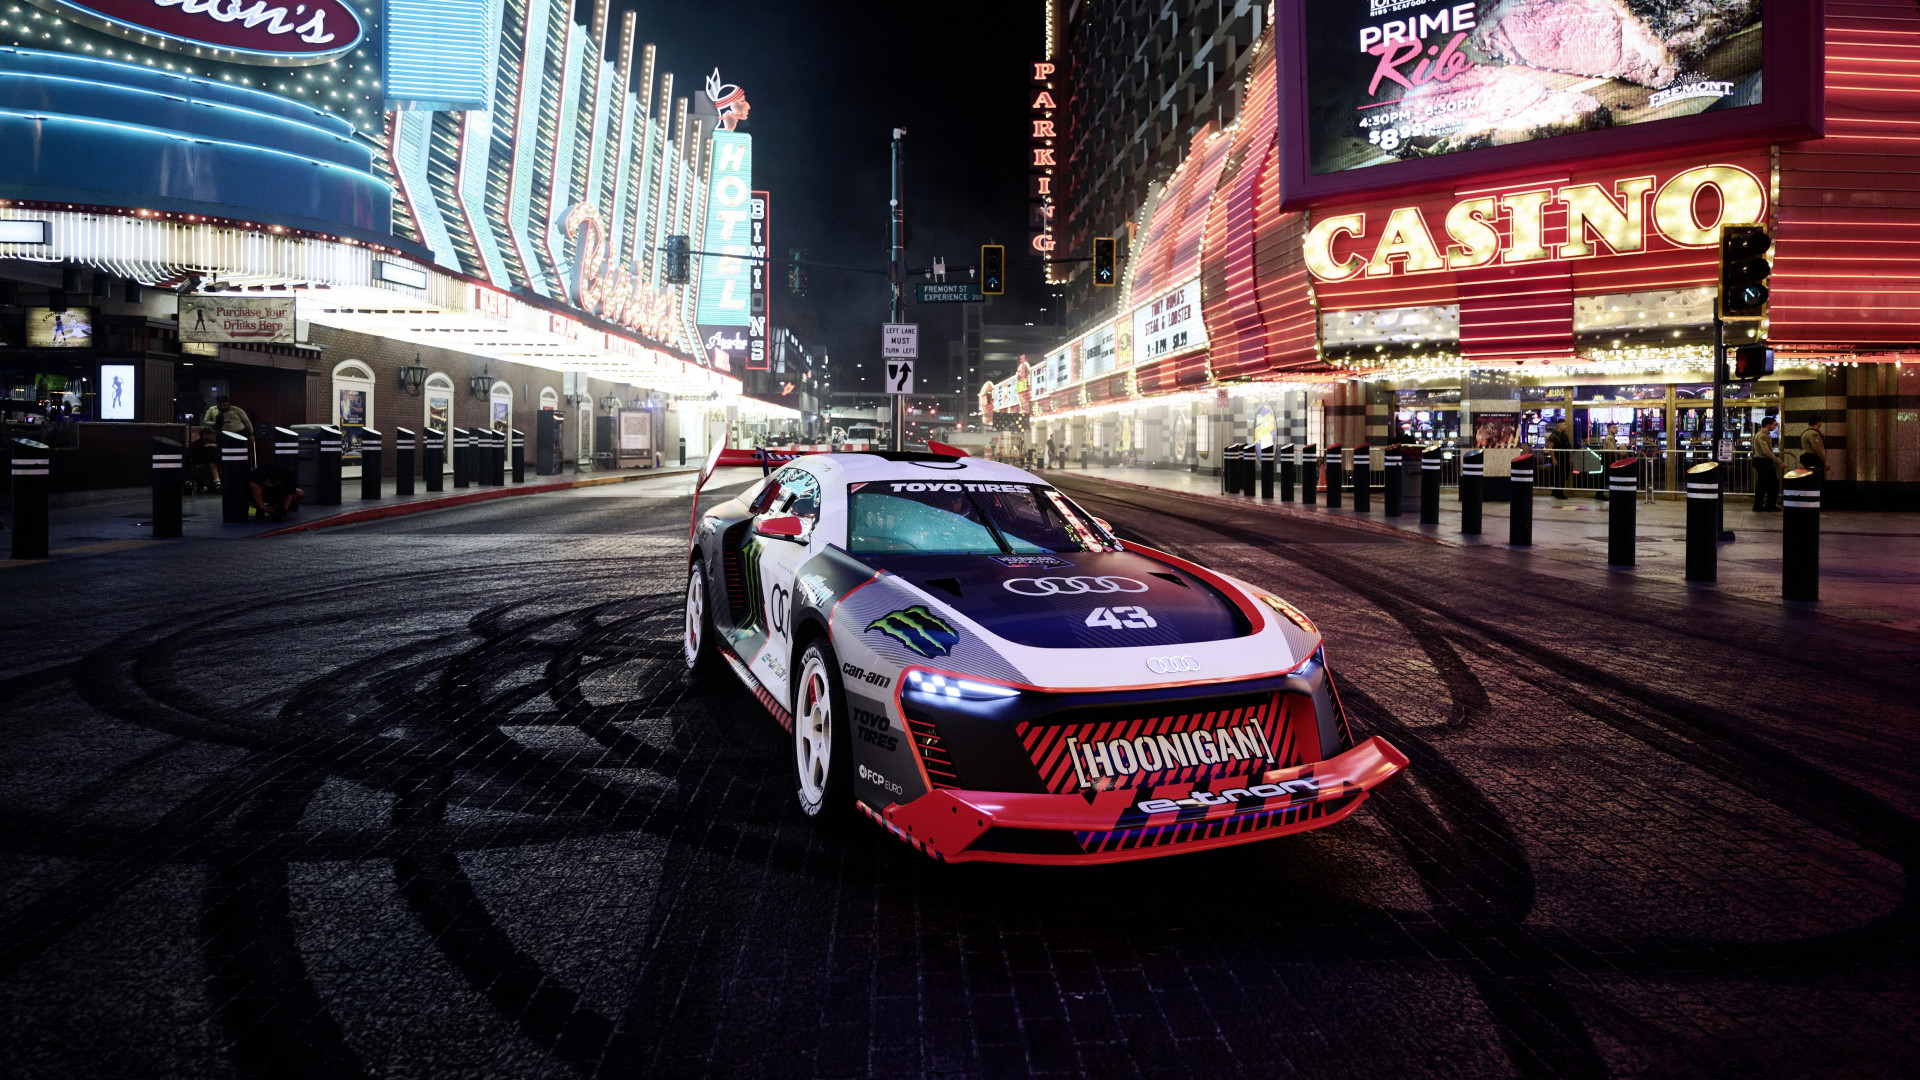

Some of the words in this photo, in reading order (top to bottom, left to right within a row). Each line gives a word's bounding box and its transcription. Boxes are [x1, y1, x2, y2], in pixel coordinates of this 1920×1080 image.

[1360, 2, 1476, 52] PRIME
[1367, 32, 1475, 97] Rib
[1648, 81, 1734, 108] FREMONT
[1359, 110, 1411, 128] 4:30PM
[1424, 98, 1479, 116] 6:30PM
[1032, 62, 1057, 251] PARKING
[716, 143, 748, 310] HOTEL
[1303, 164, 1767, 283] CASINO
[924, 285, 958, 293] FREMONT
[216, 307, 261, 317] Purchase
[265, 307, 287, 318] Your
[223, 320, 256, 330] Drinks
[258, 320, 283, 331] Here
[1145, 318, 1159, 336] STEAK
[1168, 304, 1191, 327] LOBSTER
[1160, 337, 1167, 353] PM
[890, 482, 964, 492] TOYO
[963, 483, 1030, 493] TIRES
[1084, 605, 1158, 630] 43
[842, 662, 891, 688] can-am
[853, 707, 891, 732] TOYO
[857, 725, 899, 752] TIRES
[867, 769, 885, 785] FCP
[884, 779, 903, 795] EURO
[1137, 778, 1319, 814] e-tron
